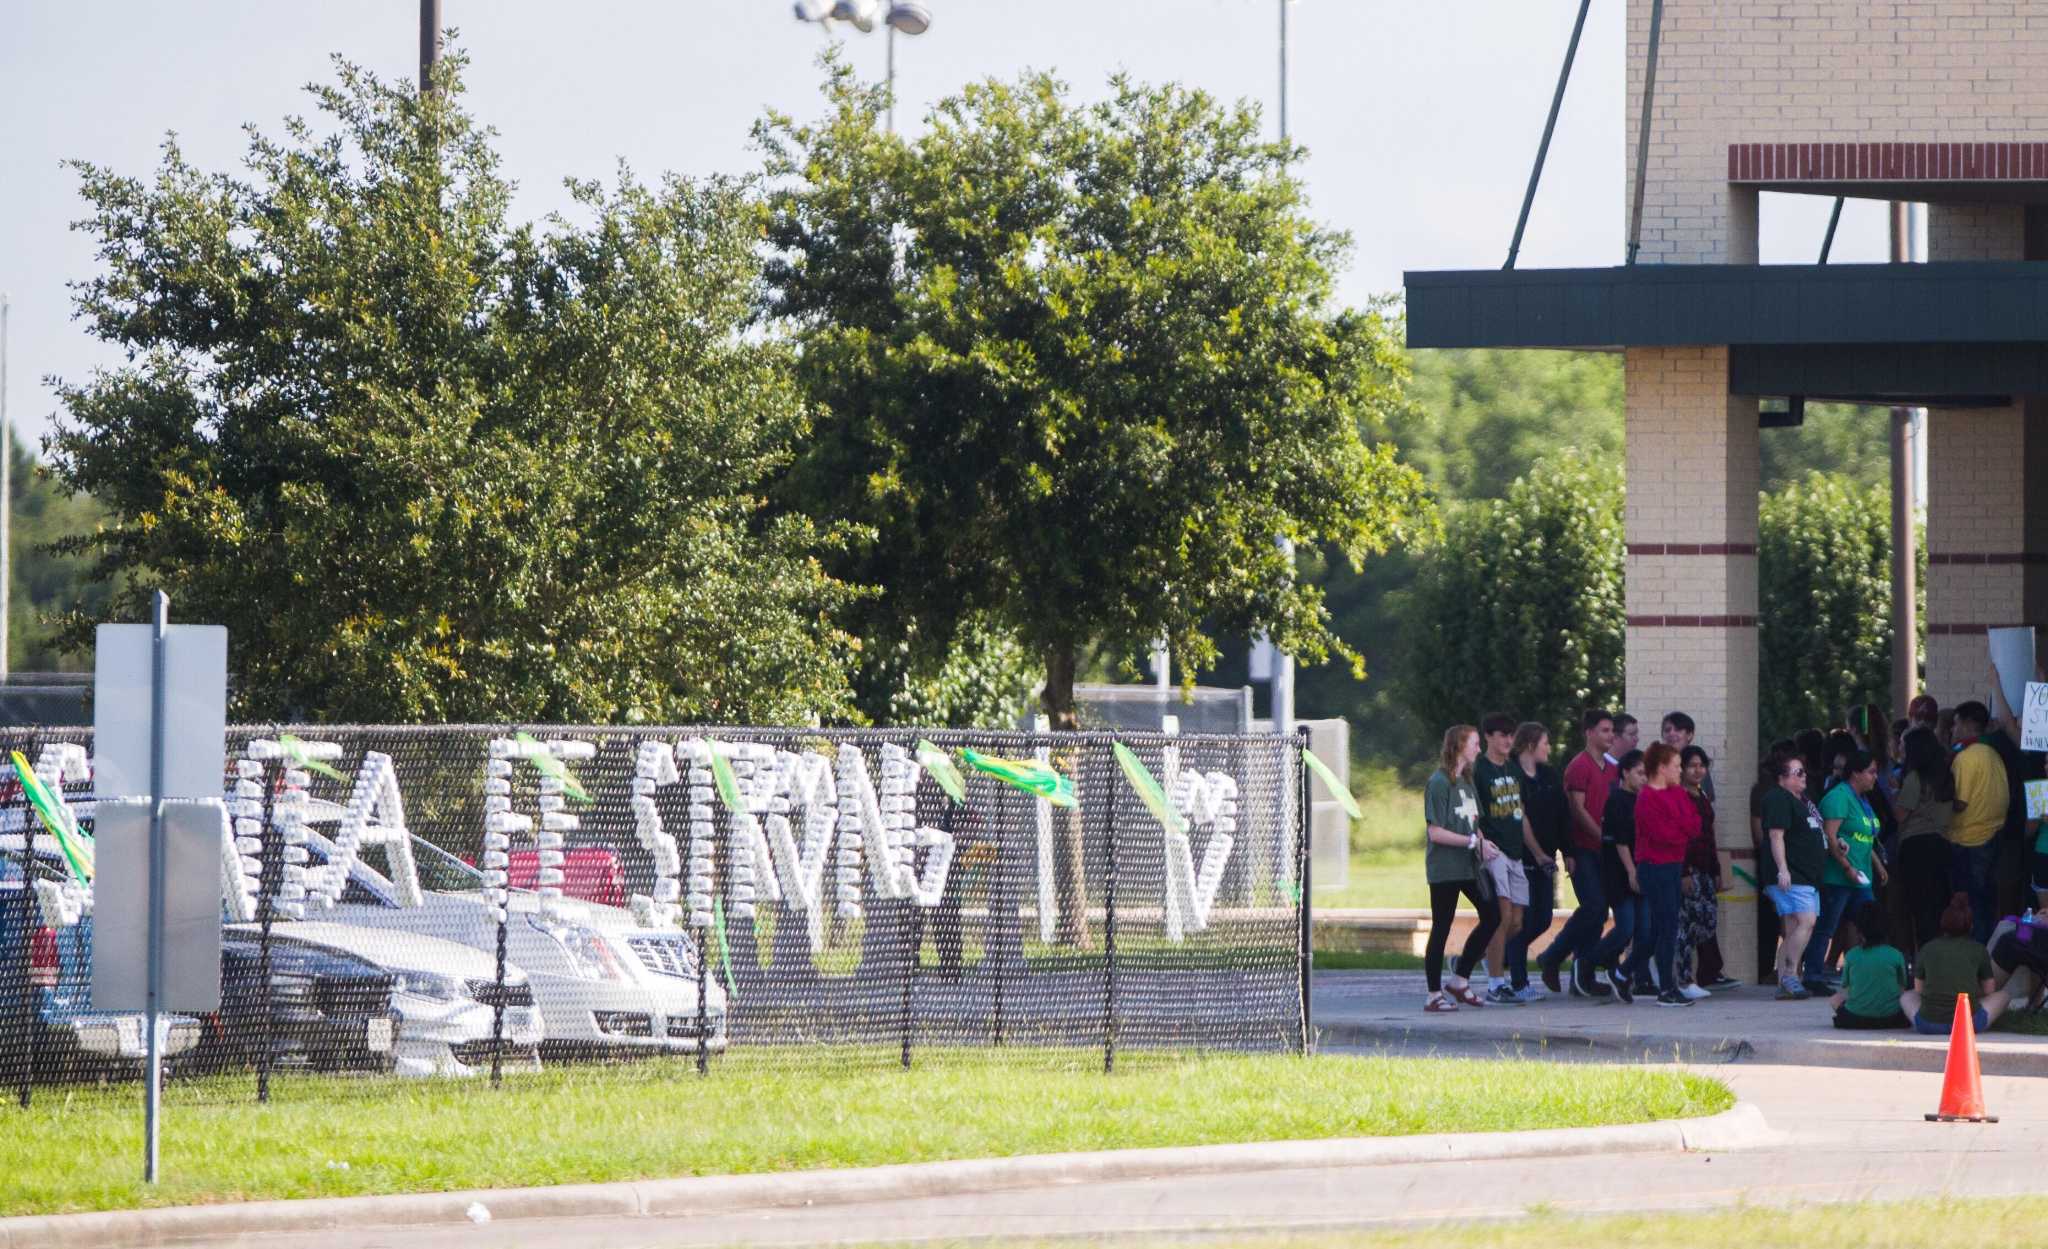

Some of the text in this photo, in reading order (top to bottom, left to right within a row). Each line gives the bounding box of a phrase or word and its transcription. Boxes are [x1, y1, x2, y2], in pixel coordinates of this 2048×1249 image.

[35, 738, 954, 926] SNTA FE STRONG
